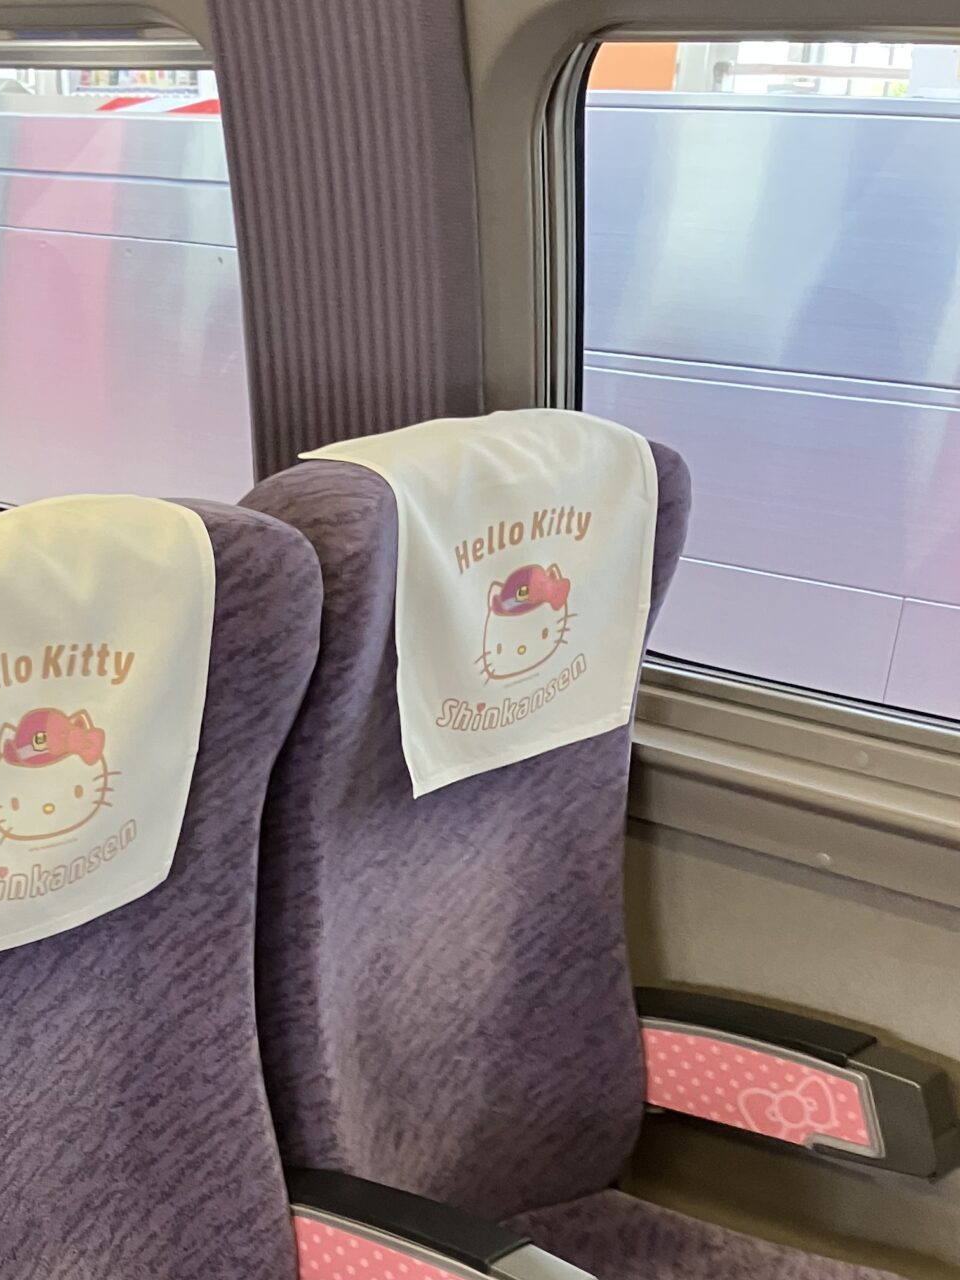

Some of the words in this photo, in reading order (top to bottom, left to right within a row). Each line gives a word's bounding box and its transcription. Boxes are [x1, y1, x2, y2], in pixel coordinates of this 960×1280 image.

[454, 520, 524, 575] Hello
[530, 505, 592, 541] Kitty
[41, 642, 136, 686] Kitty
[435, 652, 587, 732] Shinkansen
